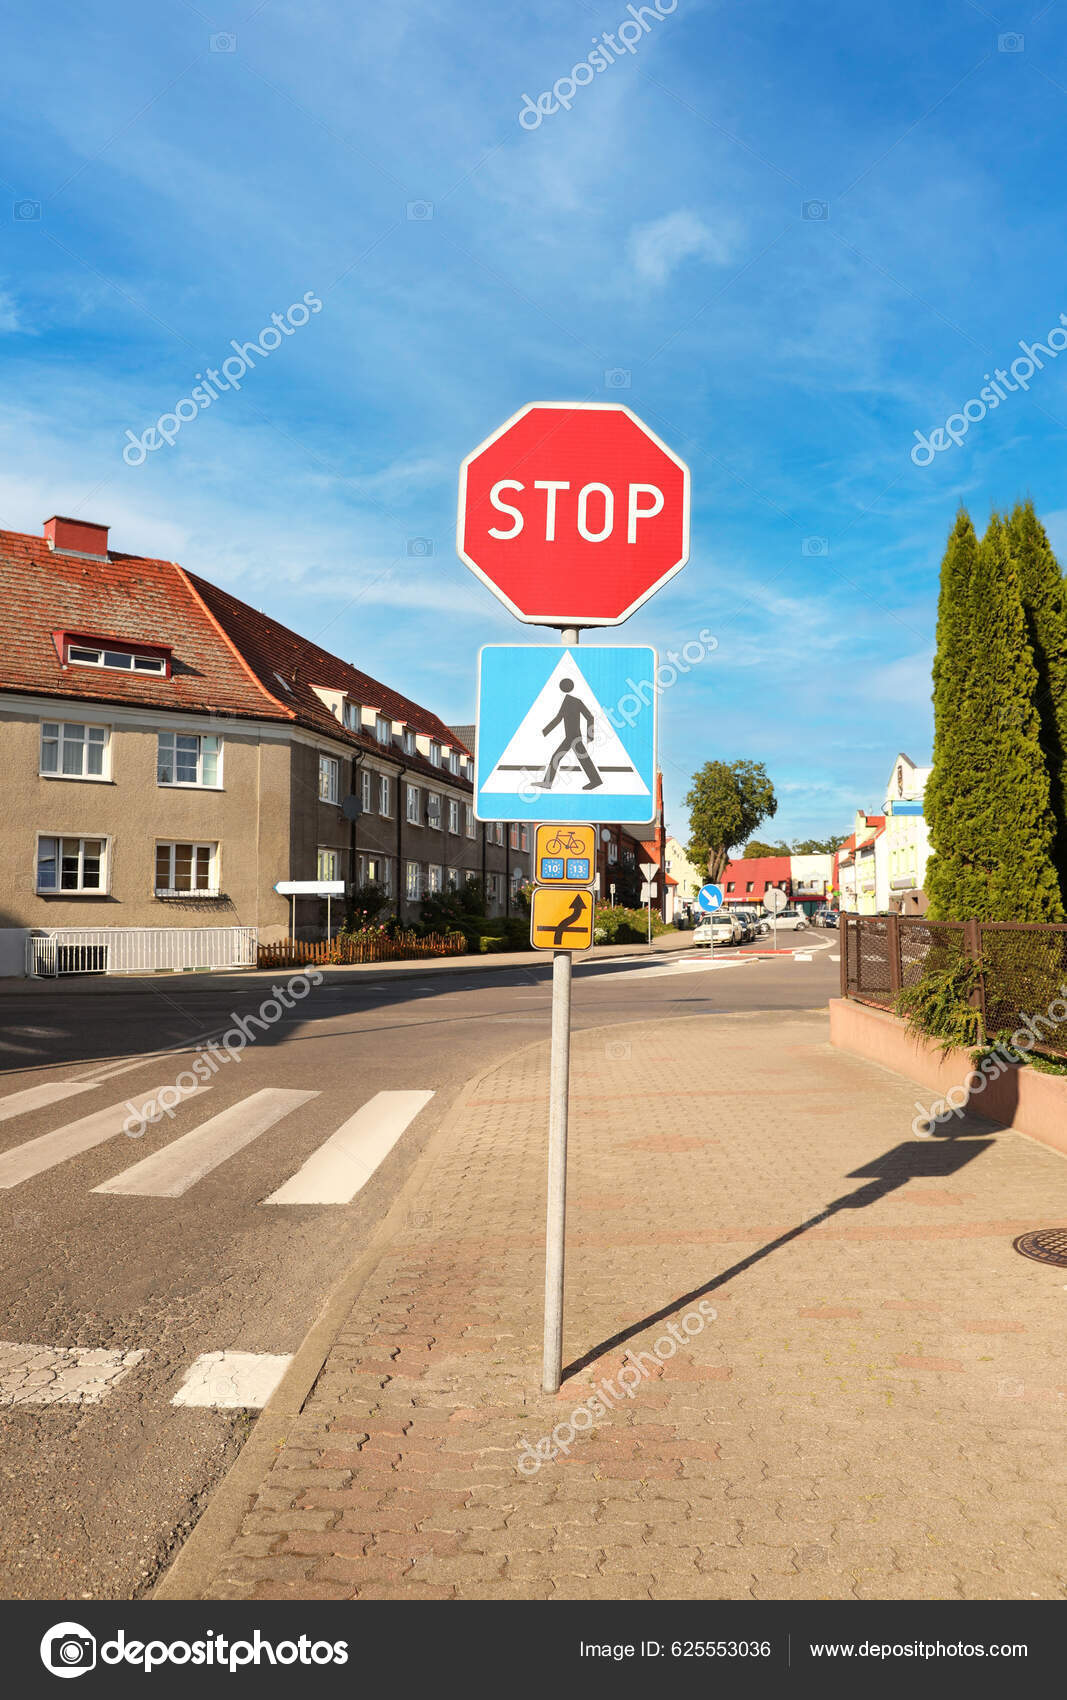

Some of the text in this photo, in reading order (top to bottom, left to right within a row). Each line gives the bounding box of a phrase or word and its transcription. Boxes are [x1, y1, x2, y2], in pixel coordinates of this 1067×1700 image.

[487, 479, 665, 544] STOP
[547, 864, 583, 873] 10 13
